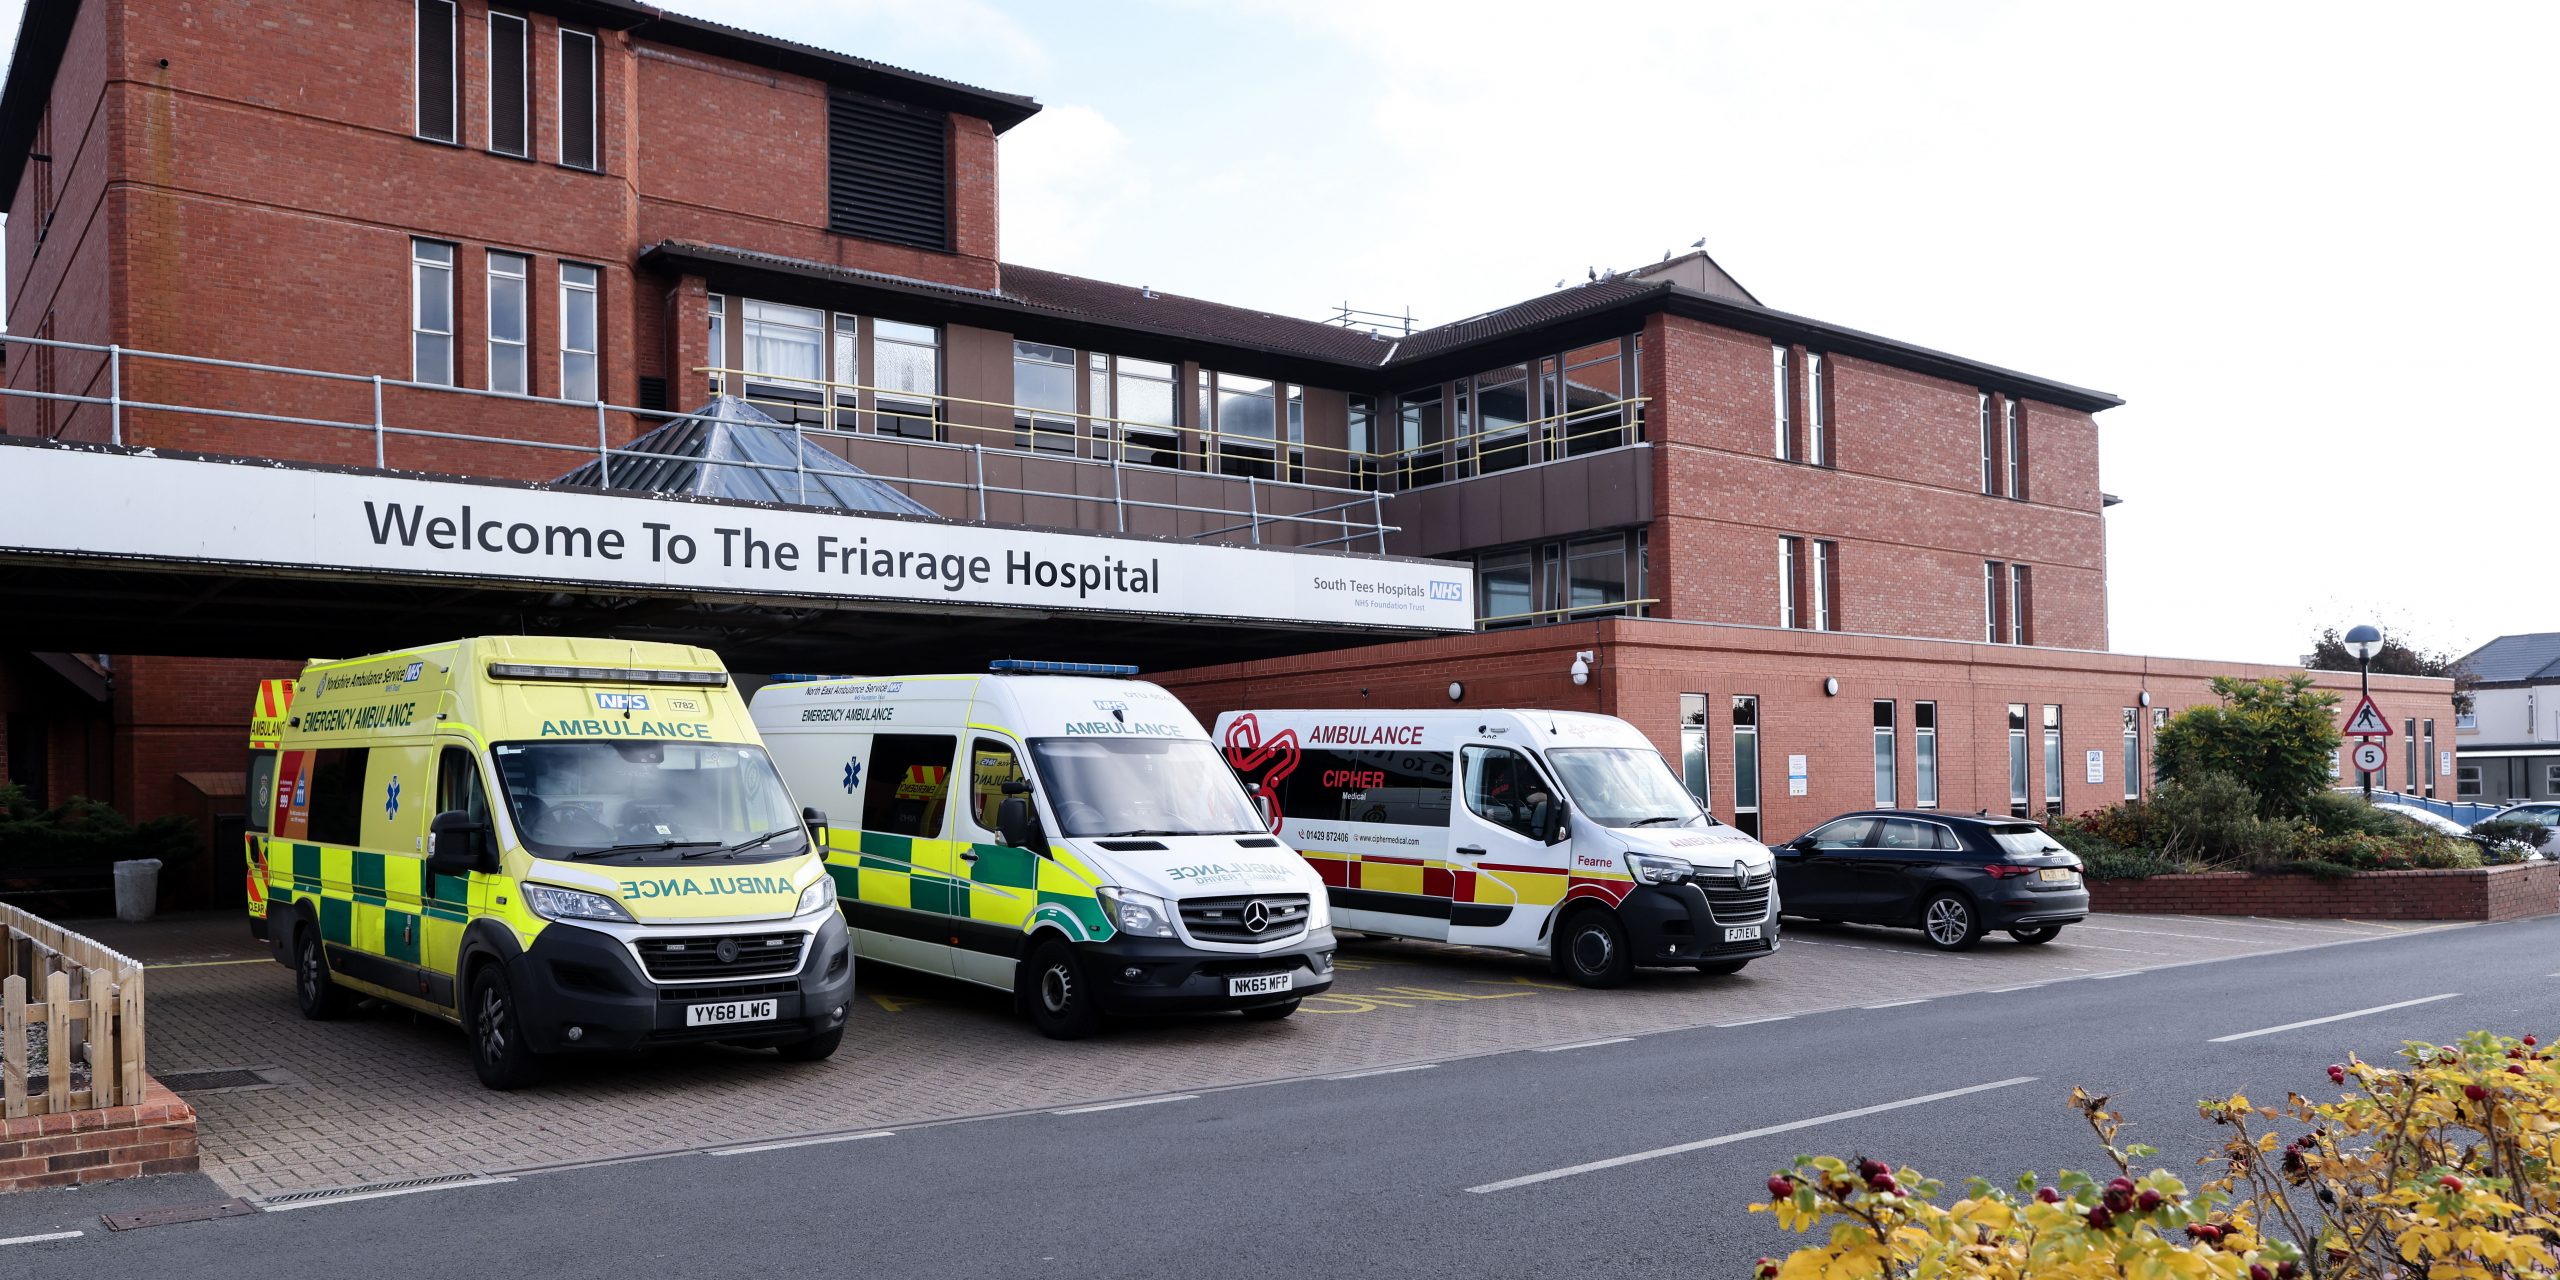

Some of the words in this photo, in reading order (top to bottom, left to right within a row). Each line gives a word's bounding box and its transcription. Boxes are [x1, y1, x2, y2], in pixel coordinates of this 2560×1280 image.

[363, 500, 625, 560] Welcome
[642, 522, 697, 565] To
[713, 527, 800, 572] The
[817, 535, 991, 592] Friarage
[1006, 549, 1159, 599] Hospital
[1313, 576, 1347, 591] South
[1350, 579, 1374, 593] Tees
[1377, 582, 1425, 599] Hospitals
[1430, 582, 1462, 600] NHS
[1355, 599, 1369, 608] NHS
[1371, 600, 1408, 611] Foundation
[1409, 602, 1425, 612] Trust
[326, 674, 351, 691] Yorkshire
[350, 669, 383, 688] Ambulance
[382, 666, 405, 684] Service
[405, 662, 423, 682] NHS
[805, 687, 821, 696] North
[820, 685, 834, 695] East
[833, 685, 864, 695] Ambulance
[864, 683, 888, 693] Service
[887, 682, 903, 692] NHS
[599, 694, 646, 709] NHS
[672, 701, 695, 710] 1782
[1095, 700, 1127, 710] NHS
[303, 708, 356, 733] EMERGENCY
[353, 702, 416, 730] AMBULANCE
[801, 708, 845, 722] EMERGENCY
[845, 707, 894, 721] AMBULANCE
[250, 720, 285, 736] AMBULANC
[541, 719, 712, 739] AMBULANCE
[1065, 722, 1185, 738] AMBULANCE
[1308, 725, 1425, 745] AMBULANCE
[2364, 751, 2375, 764] 5
[1322, 769, 1385, 789] CIPHER
[280, 794, 289, 808] 999
[1342, 791, 1367, 801] Medical
[1306, 830, 1325, 841] 01429
[1325, 831, 1349, 842] 872406
[1359, 834, 1420, 846] www.ciphermedical.com
[1577, 855, 1613, 868] Fearne
[249, 901, 265, 914] CLEAR
[1729, 928, 1745, 940] FJ71
[1745, 927, 1758, 938] EVL
[1235, 978, 1267, 993] NK65
[1269, 975, 1288, 990] MFP
[695, 1004, 736, 1022] YY68
[740, 1001, 770, 1019] LWG
